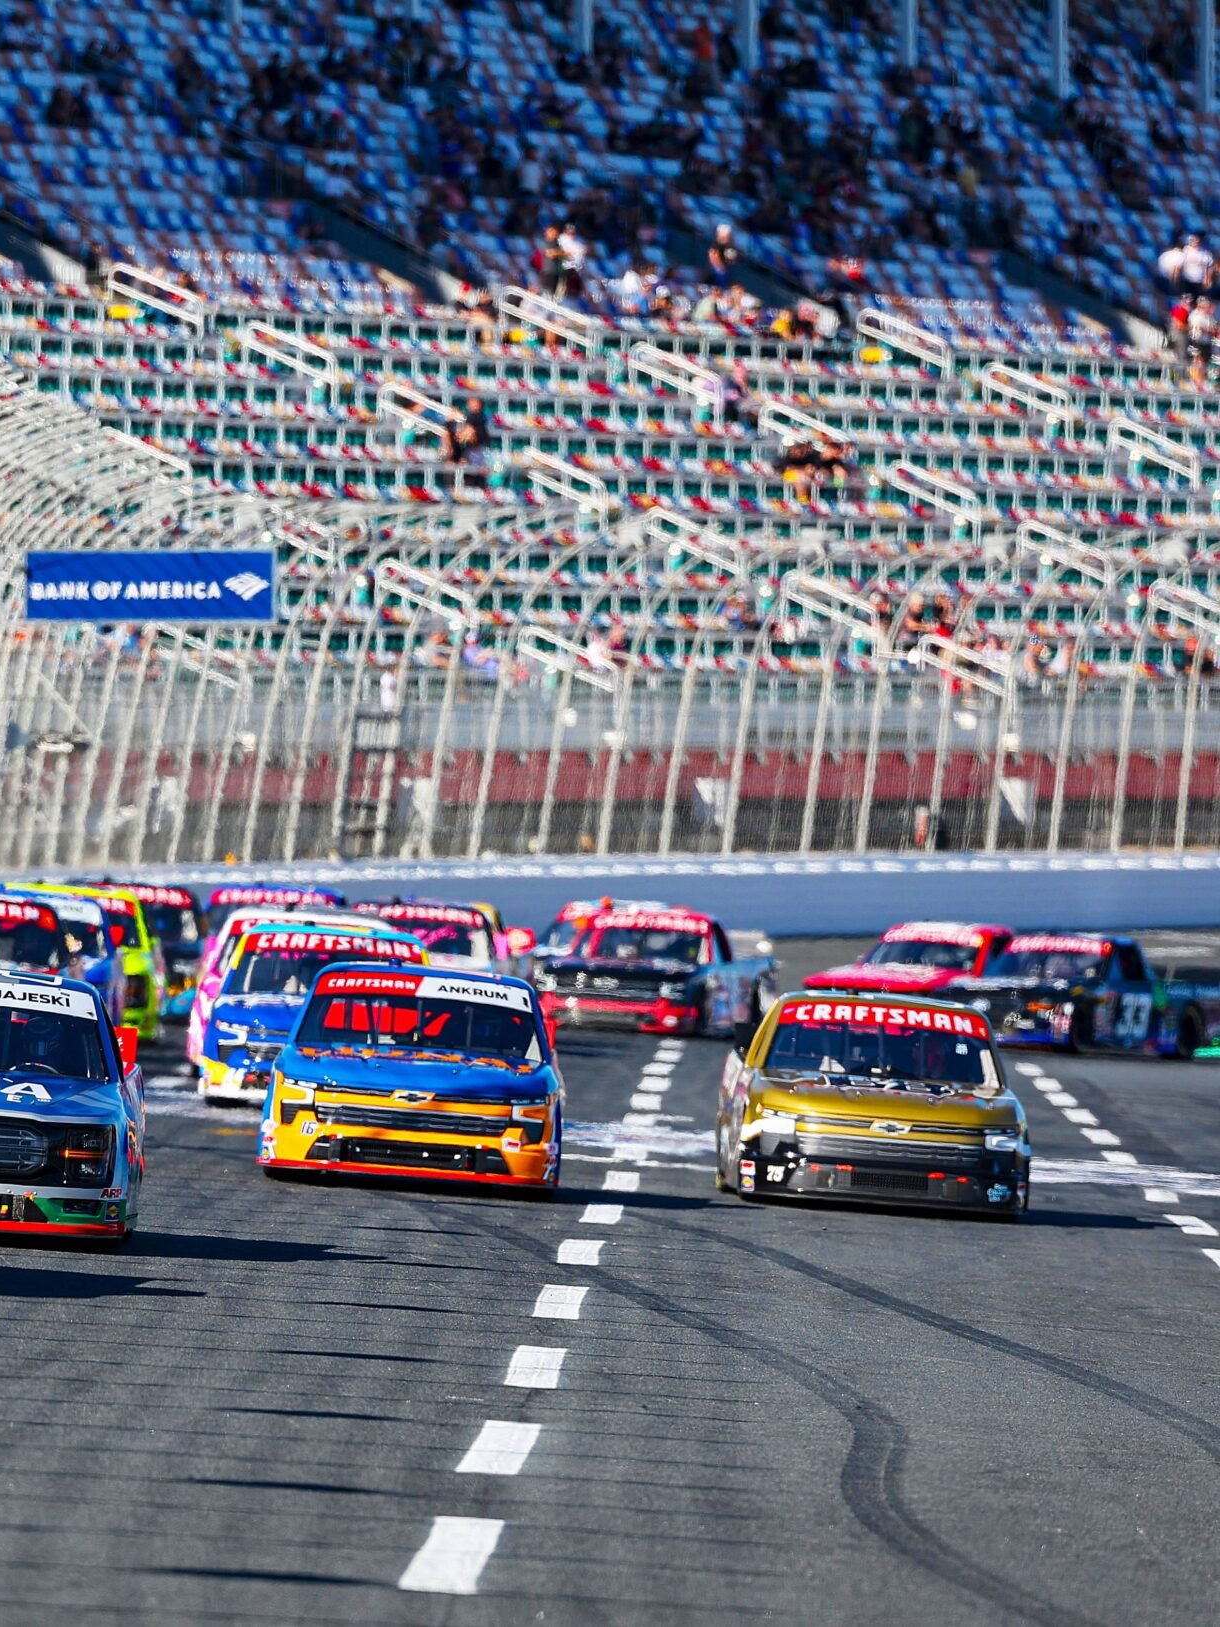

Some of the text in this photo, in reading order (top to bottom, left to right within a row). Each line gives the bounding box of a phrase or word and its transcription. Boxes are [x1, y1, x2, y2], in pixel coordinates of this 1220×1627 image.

[30, 580, 221, 600] BANK OF AMERICA
[257, 933, 412, 957] CRAFTSMAN
[327, 977, 416, 990] CRAFTSMAN
[438, 984, 509, 1001] ANKRUM
[795, 1003, 973, 1034] CRAFTSMAN
